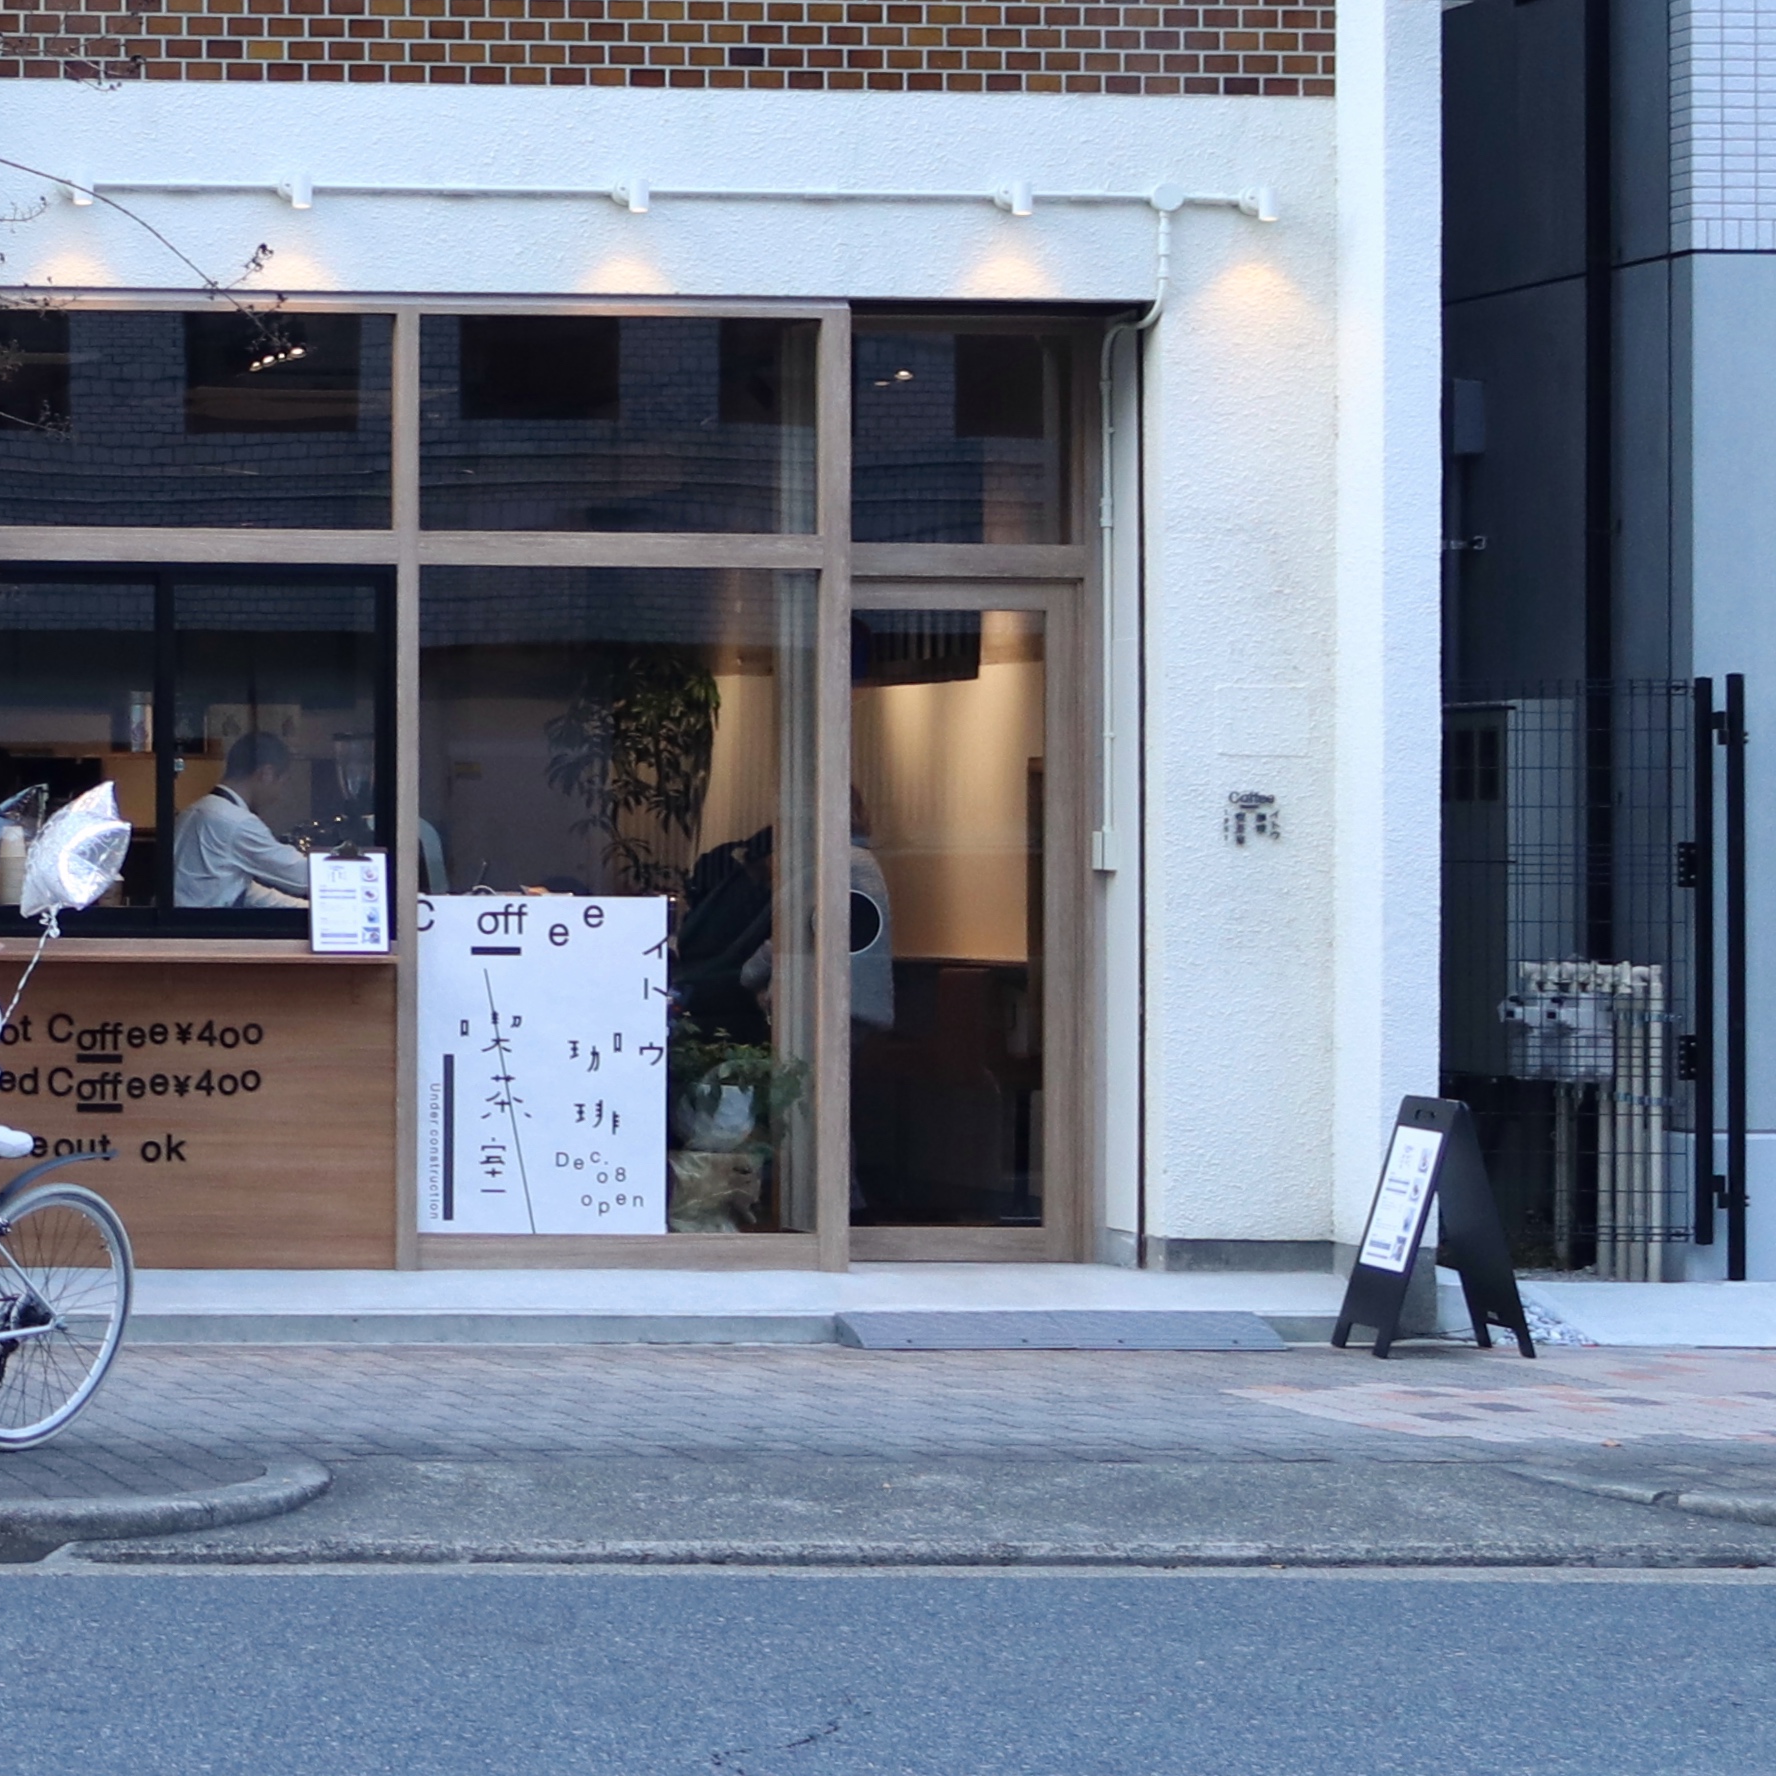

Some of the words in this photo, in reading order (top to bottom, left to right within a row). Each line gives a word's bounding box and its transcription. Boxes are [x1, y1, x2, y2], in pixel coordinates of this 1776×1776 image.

[0, 1015, 32, 1046] ot
[47, 1013, 169, 1052] Coffee
[47, 1067, 169, 1101] Coffee
[429, 1083, 442, 1125] Under
[140, 1133, 186, 1163] ok
[429, 1129, 442, 1221] construction
[580, 1193, 644, 1217] open
